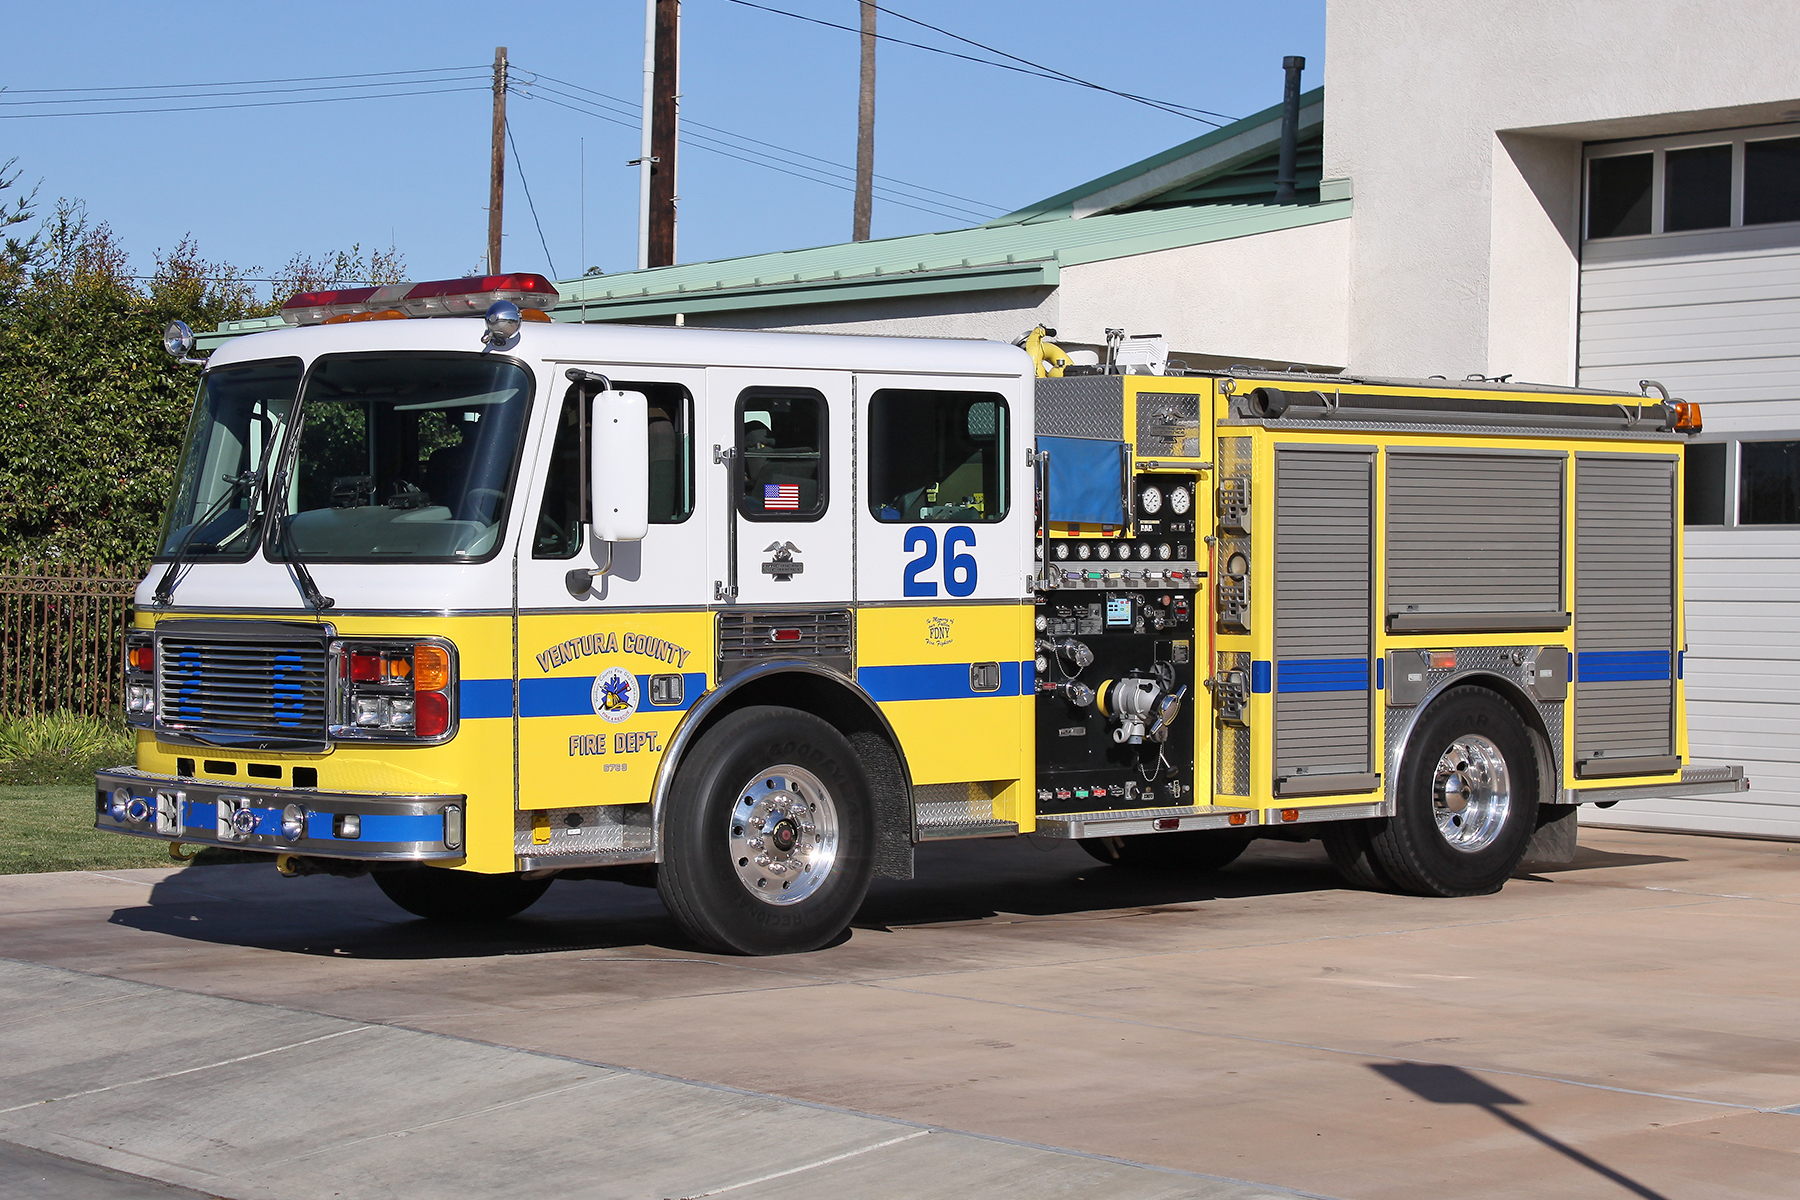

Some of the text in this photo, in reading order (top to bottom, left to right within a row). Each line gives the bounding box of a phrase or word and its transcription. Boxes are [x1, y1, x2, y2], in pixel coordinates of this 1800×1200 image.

[903, 525, 978, 597] 26
[930, 627, 950, 639] FDNY
[535, 632, 692, 674] VENTURA COUNTY
[569, 731, 662, 757] FIRE DEPT.
